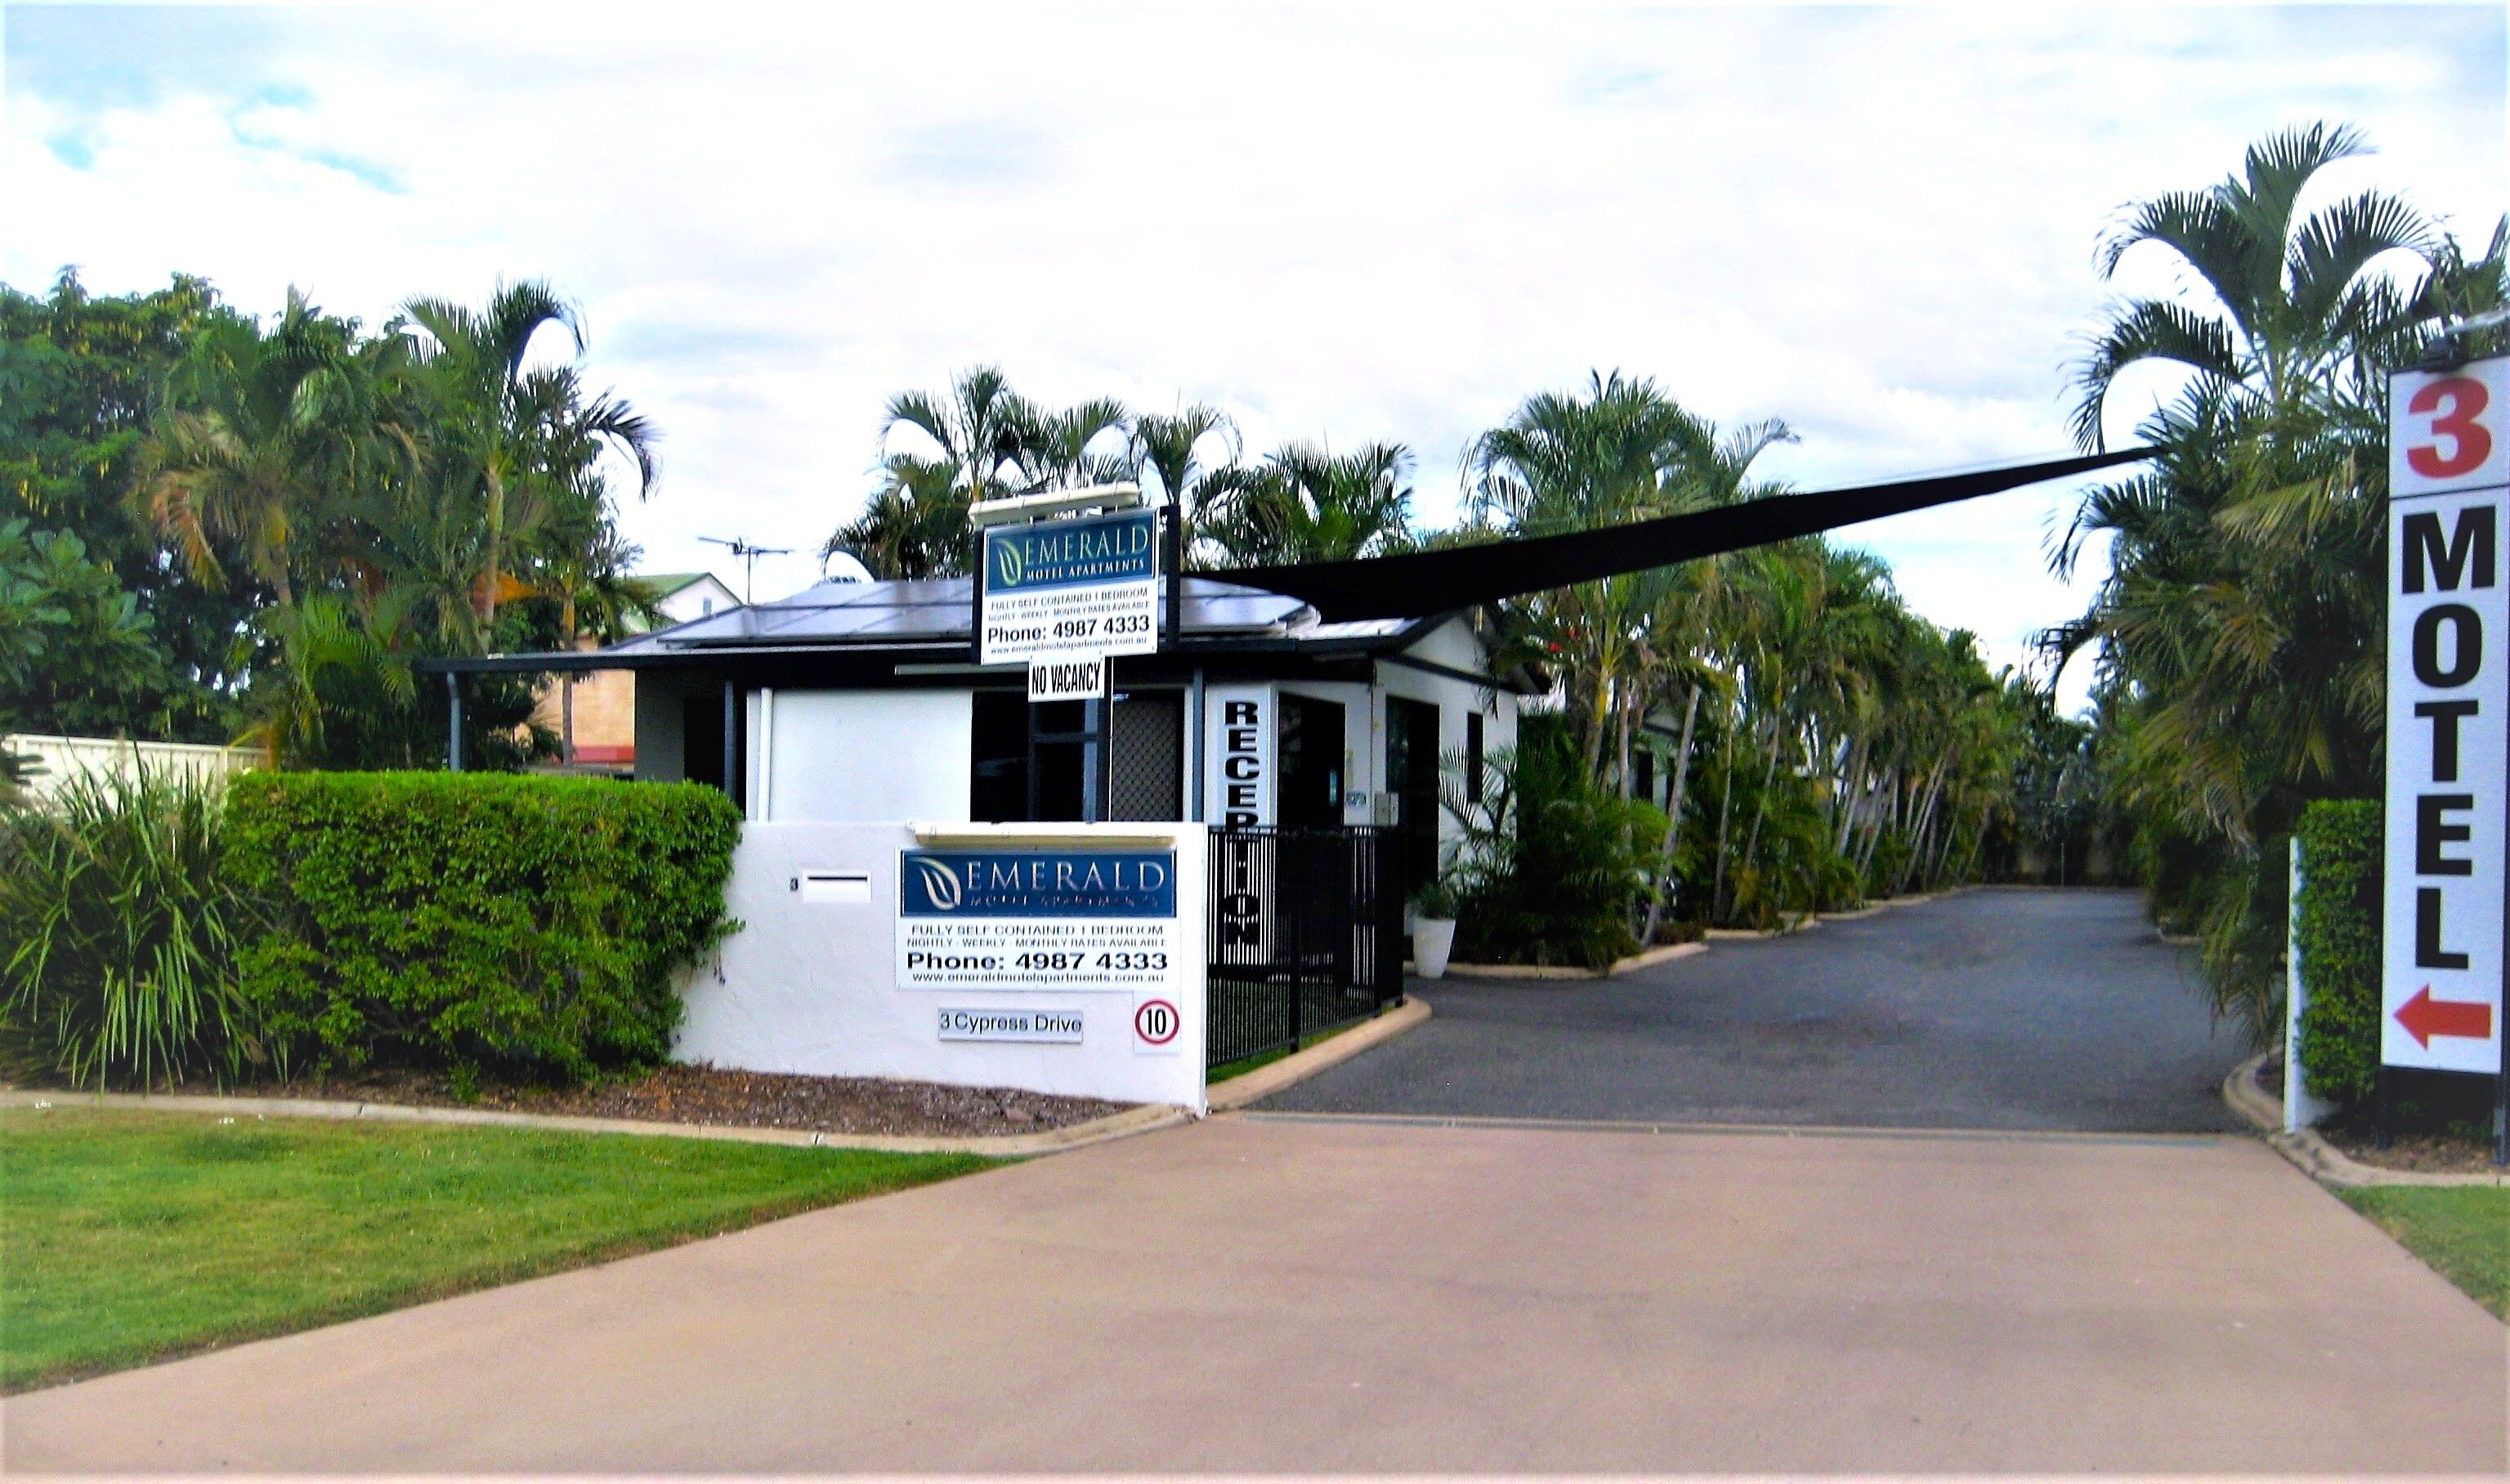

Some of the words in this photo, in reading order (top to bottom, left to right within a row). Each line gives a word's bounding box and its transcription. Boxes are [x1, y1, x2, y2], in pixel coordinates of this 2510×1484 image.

[2405, 375, 2492, 480] 3
[1025, 524, 1148, 565] EMERALD
[1026, 565, 1063, 581] MOTEL
[1068, 557, 1144, 578] APARTMENTS
[991, 599, 1016, 610] FULLY
[1018, 597, 1039, 609] SELF
[1041, 592, 1092, 607] CONTAINED
[1103, 587, 1148, 601] BEDROOM
[988, 625, 1047, 643] Phone:
[1053, 618, 1097, 639] 4987
[1103, 615, 1150, 635] 4333
[1031, 664, 1046, 695] NO
[1051, 662, 1101, 694] VACANCY
[2401, 505, 2496, 970] MOTEL
[967, 860, 1166, 892] EMERALD
[907, 937, 953, 948] NIGHTLY
[962, 937, 1005, 948] WEEKLY
[1016, 937, 1067, 948] MONTHLY
[1109, 937, 1167, 948] AVAILABLE
[911, 924, 953, 936] FULLY
[958, 924, 990, 936] SELF
[995, 924, 1075, 936] CONTAINED
[1091, 925, 1163, 936] BEDROOM
[907, 951, 1004, 970] Phone:
[1015, 951, 1085, 971] 4987
[1095, 951, 1168, 971] 4333
[912, 972, 1164, 985] www.emeraldmotelapartments.com.au
[940, 1012, 951, 1030] 3
[955, 1012, 1028, 1034] Cypress
[1035, 1014, 1081, 1032] Drive
[1146, 1008, 1166, 1035] 10
